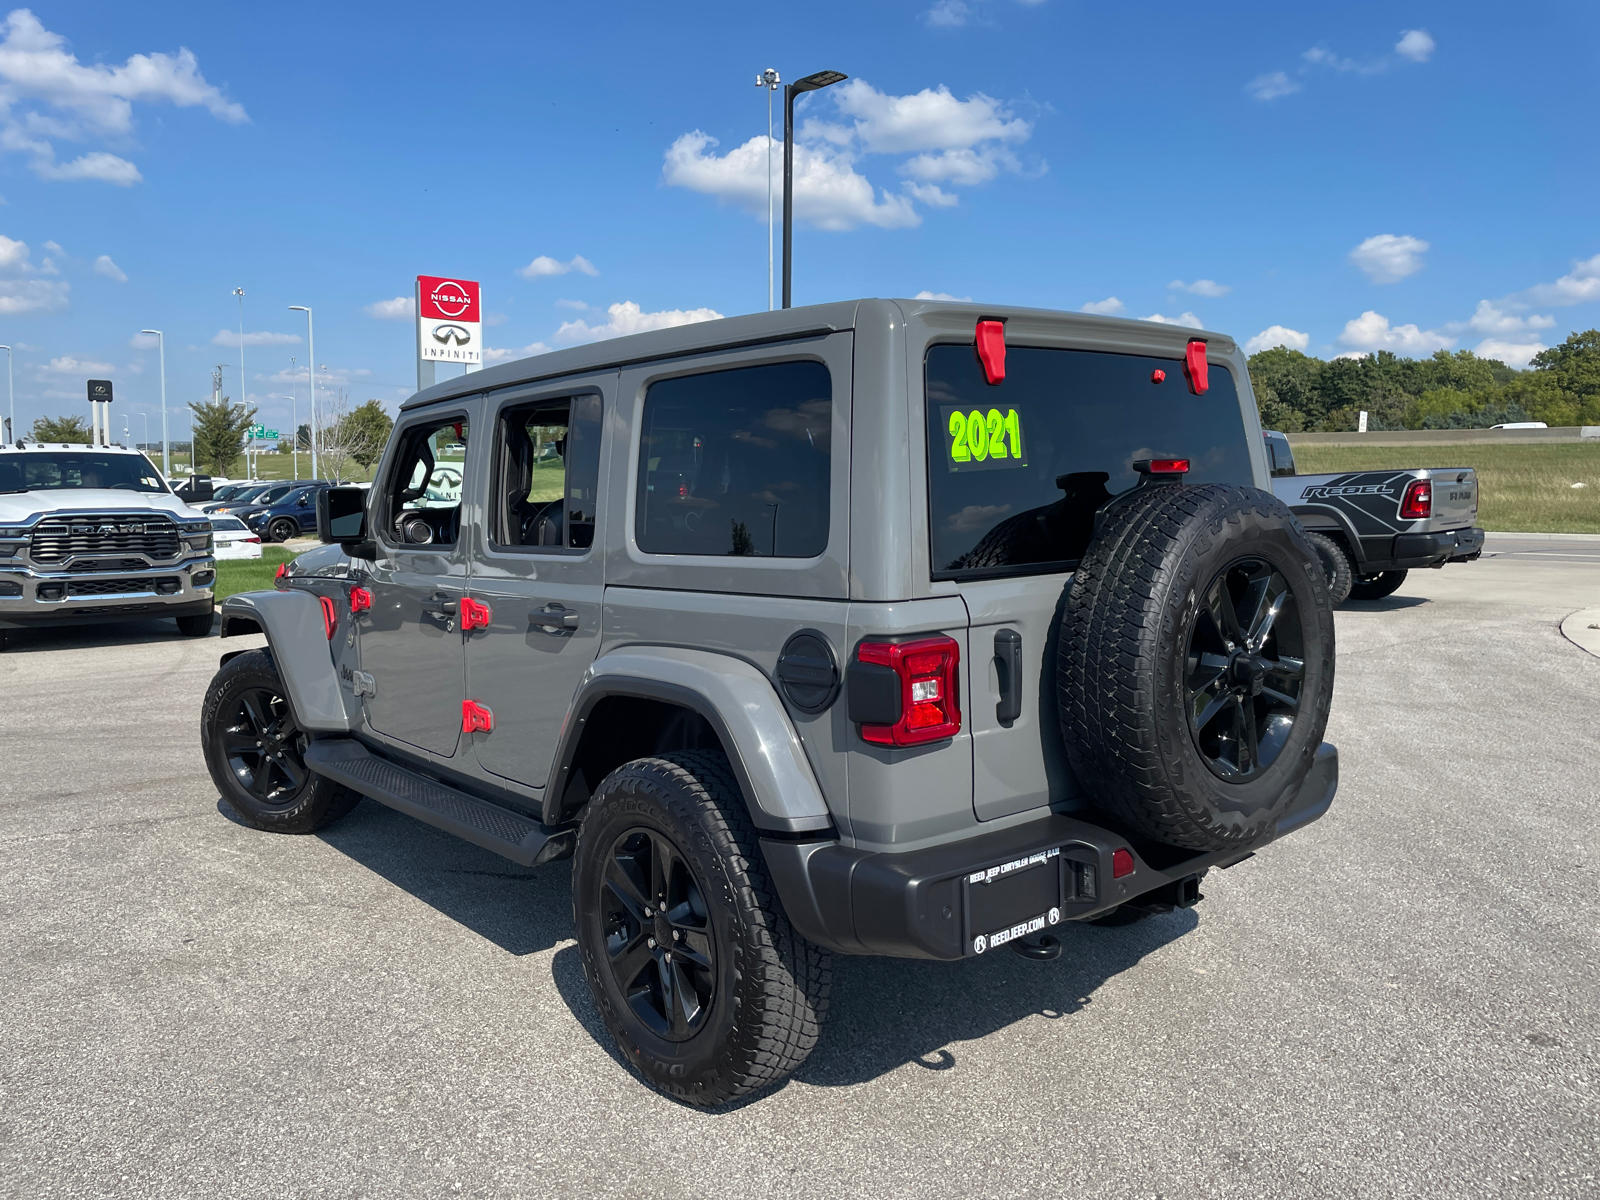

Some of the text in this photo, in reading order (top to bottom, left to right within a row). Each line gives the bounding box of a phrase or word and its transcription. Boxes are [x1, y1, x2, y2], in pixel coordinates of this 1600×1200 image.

[431, 293, 471, 304] NISSAN
[424, 347, 479, 360] INFINITI
[948, 408, 1021, 462] 2021
[1300, 484, 1394, 500] REBEL
[1449, 491, 1472, 501] RAM
[71, 524, 143, 535] RAM
[970, 871, 985, 884] REED
[985, 866, 1000, 879] JEEP
[1001, 857, 1029, 873] CHRYSLER
[1047, 847, 1060, 858] RAM
[990, 916, 1045, 948] REEDJEEP.COM
